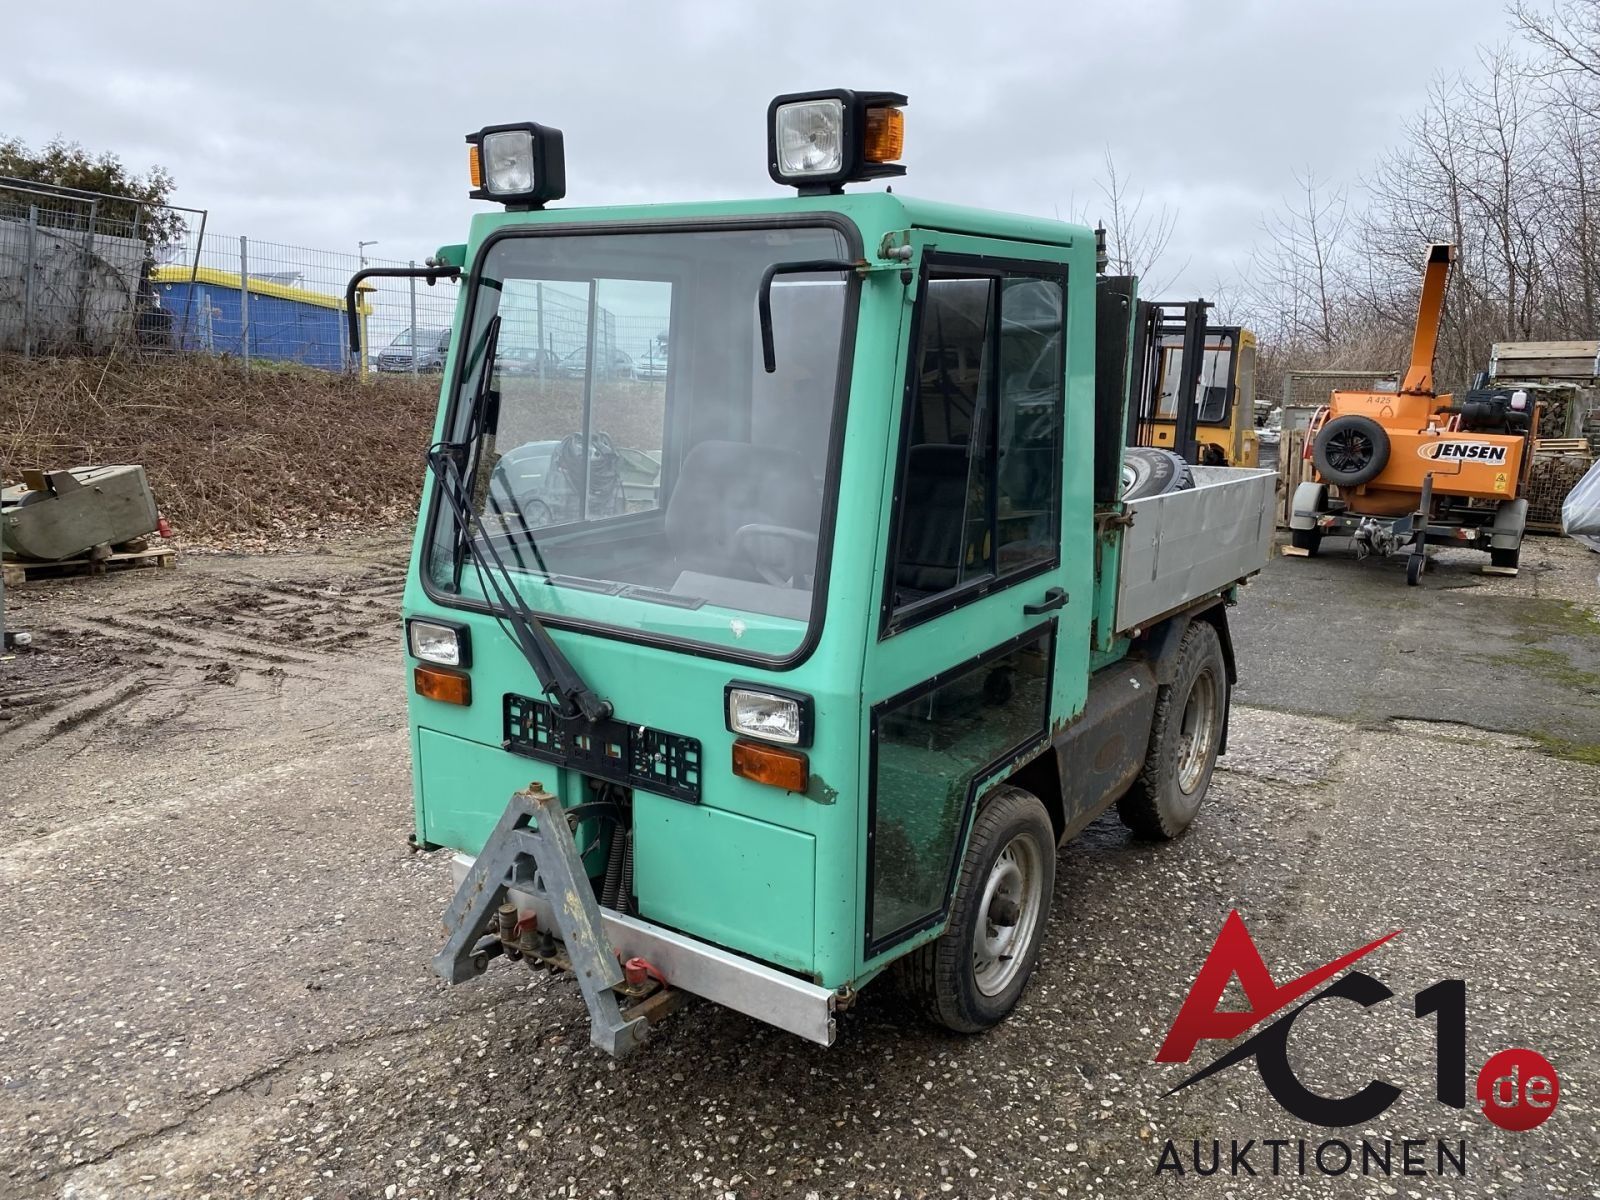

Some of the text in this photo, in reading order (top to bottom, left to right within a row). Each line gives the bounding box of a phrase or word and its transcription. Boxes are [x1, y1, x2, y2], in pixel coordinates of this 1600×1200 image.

[1366, 396, 1391, 404] A 425
[1430, 443, 1506, 460] JENSEN
